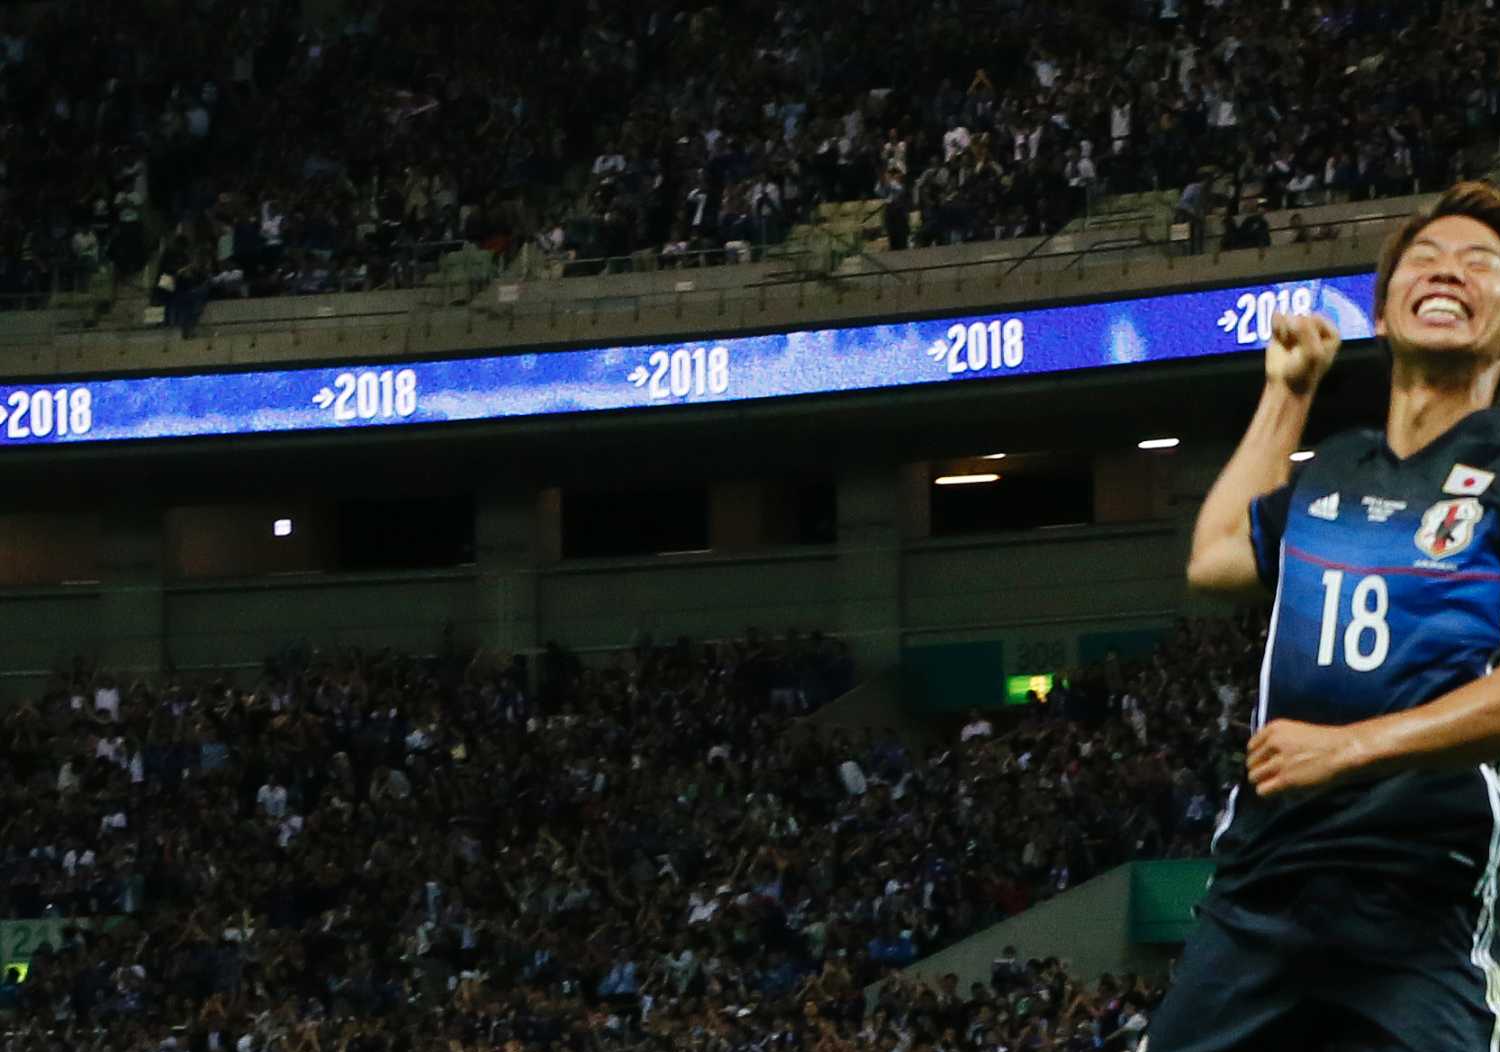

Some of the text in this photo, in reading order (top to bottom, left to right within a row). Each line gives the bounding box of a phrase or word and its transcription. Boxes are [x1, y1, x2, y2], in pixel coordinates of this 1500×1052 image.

[648, 346, 730, 400] 2018
[947, 319, 1023, 374] 2018
[7, 388, 91, 438] 2018
[334, 369, 416, 421] 2018
[1317, 569, 1390, 672] 18
